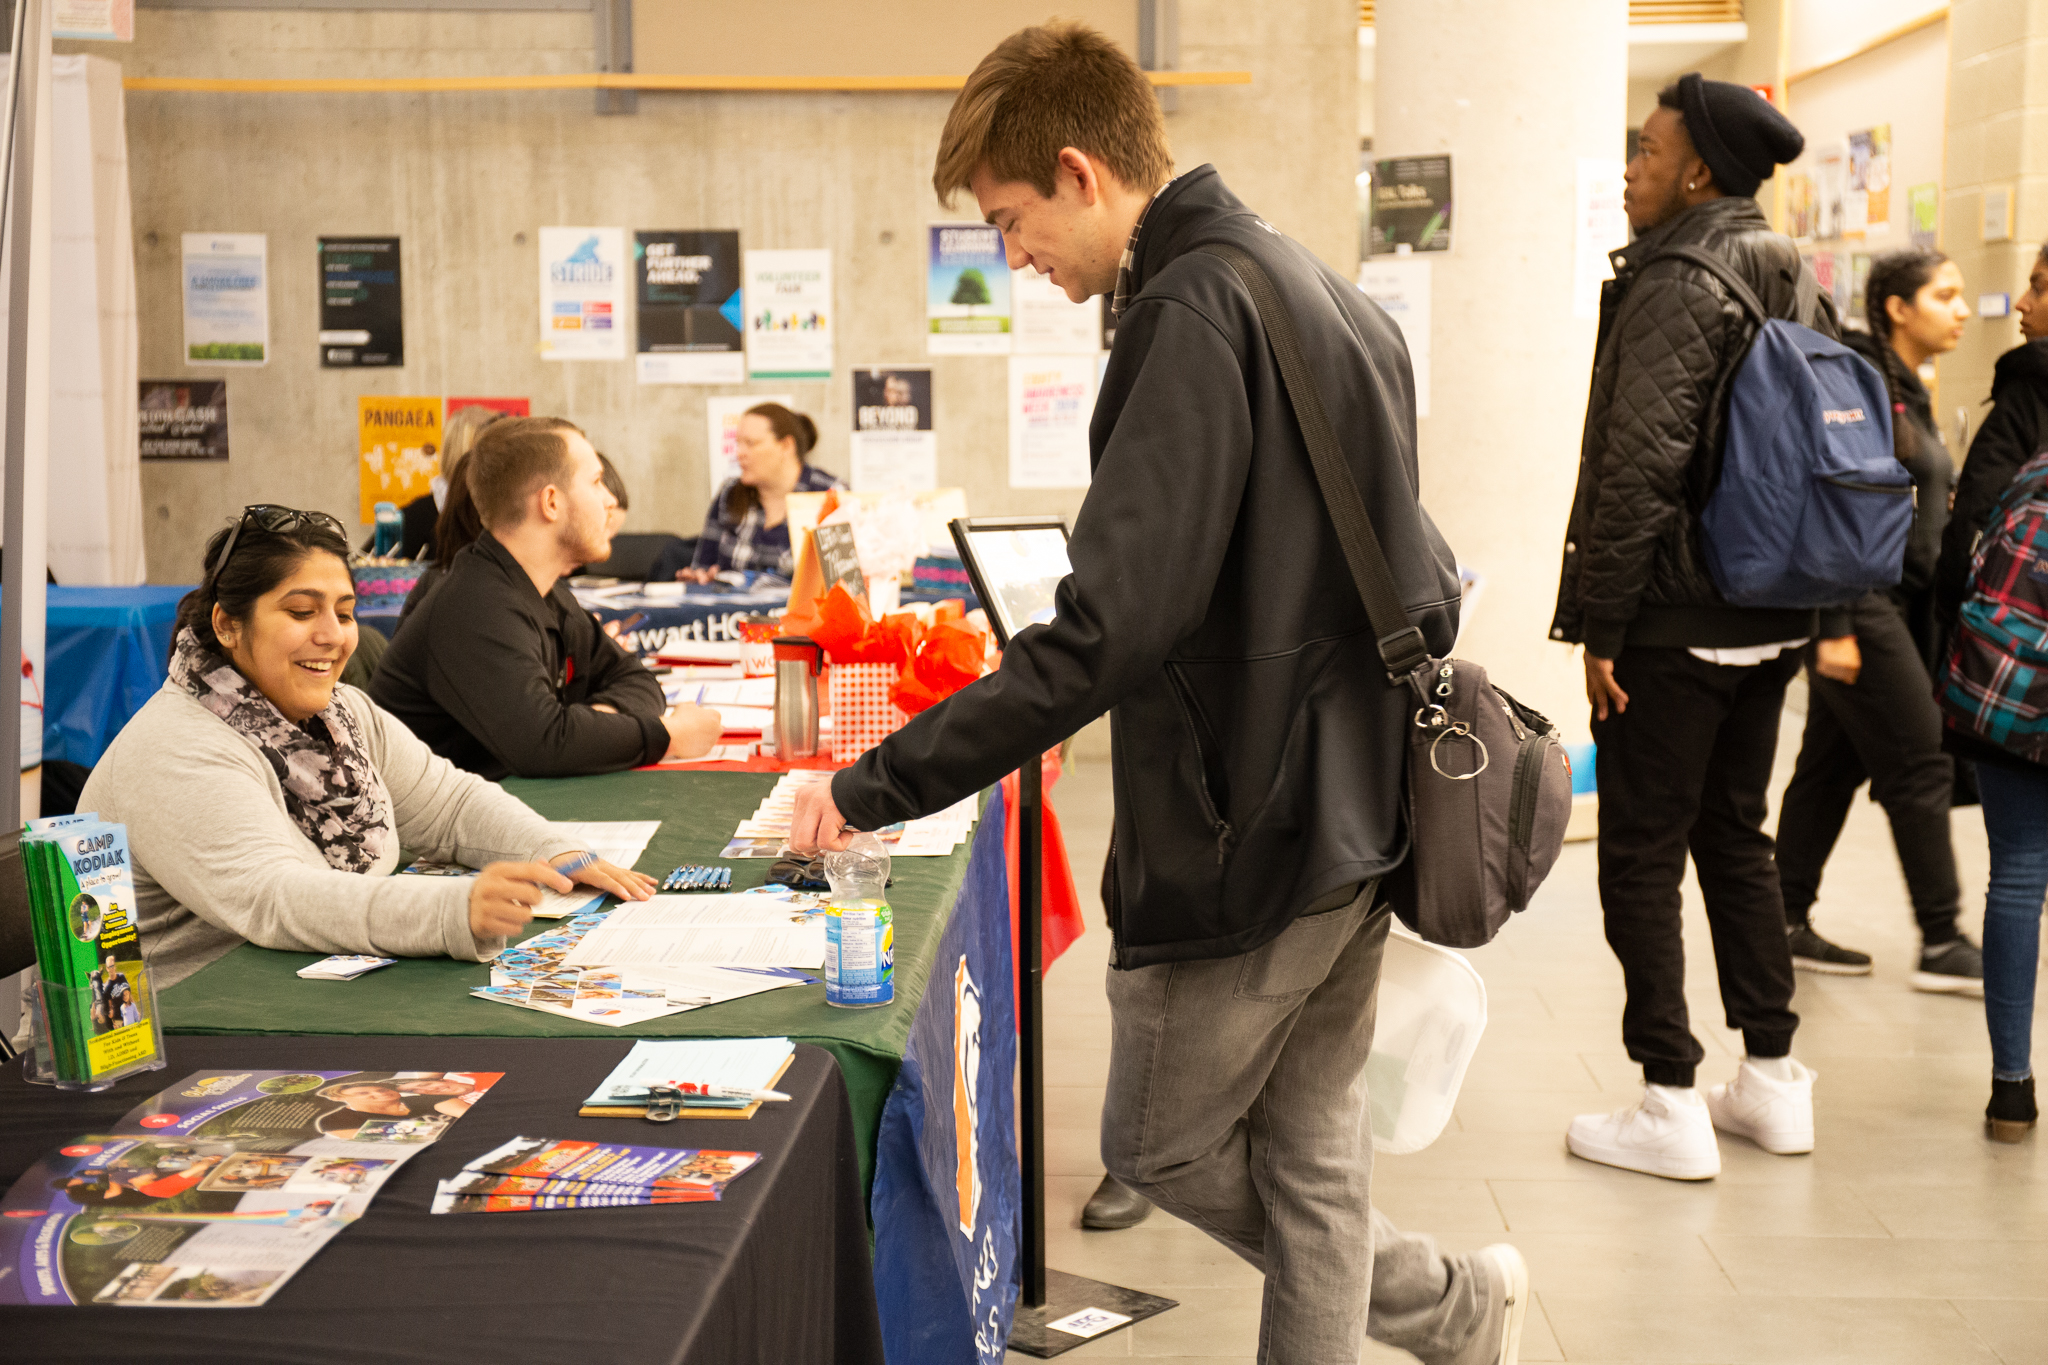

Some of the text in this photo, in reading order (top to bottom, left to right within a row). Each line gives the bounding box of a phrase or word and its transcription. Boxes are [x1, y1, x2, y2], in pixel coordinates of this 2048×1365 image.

[646, 243, 676, 257] GET
[646, 255, 713, 271] FURTHER
[859, 406, 918, 426] BEYOND
[77, 833, 114, 855] CAMP
[73, 849, 125, 876] KODIAK
[86, 877, 100, 890] place
[104, 918, 128, 930] Summer
[100, 925, 135, 940] Employment
[101, 932, 137, 949] Opportunity!
[177, 1106, 215, 1129] SOCIAL
[211, 1096, 249, 1112] SKILLS
